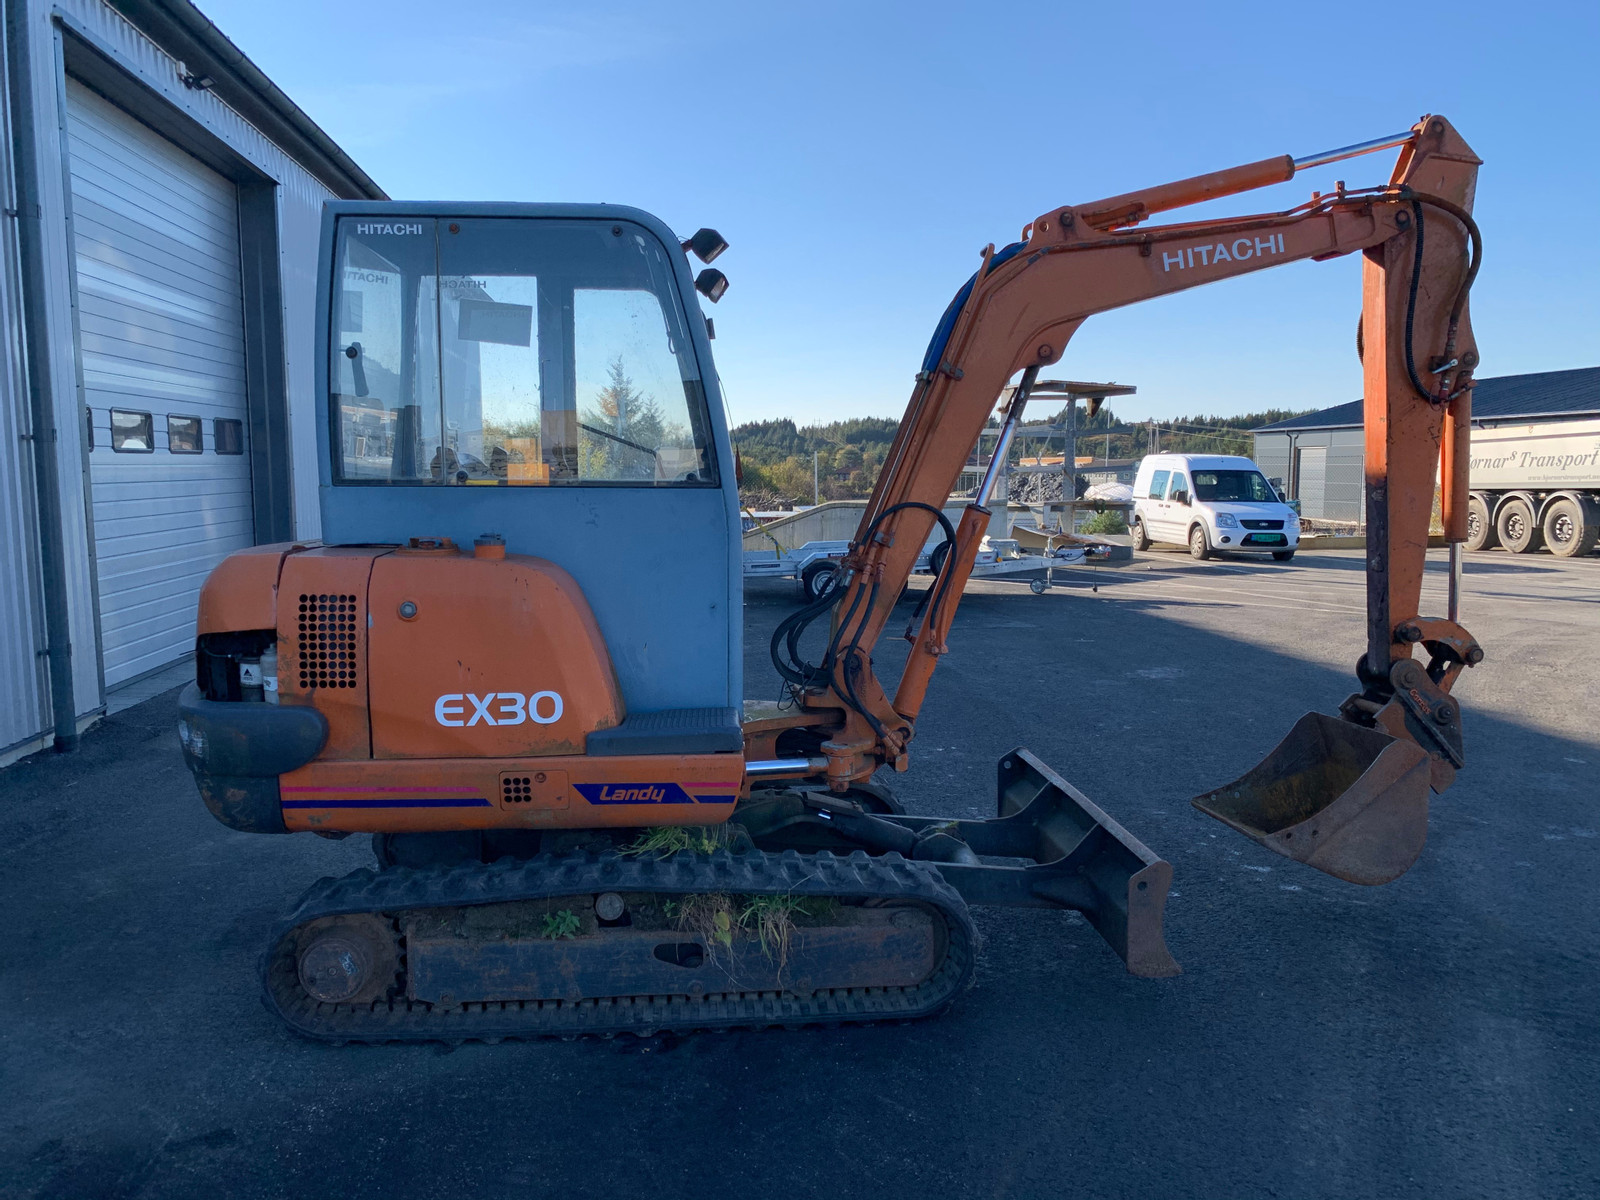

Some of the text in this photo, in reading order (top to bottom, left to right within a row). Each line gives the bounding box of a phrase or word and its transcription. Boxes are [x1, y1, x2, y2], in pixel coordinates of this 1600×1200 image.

[357, 223, 422, 235] HITACHI
[1162, 233, 1285, 272] HITACHI
[1519, 450, 1599, 471] Transport
[434, 690, 564, 727] EX30
[600, 785, 666, 803] Landy
